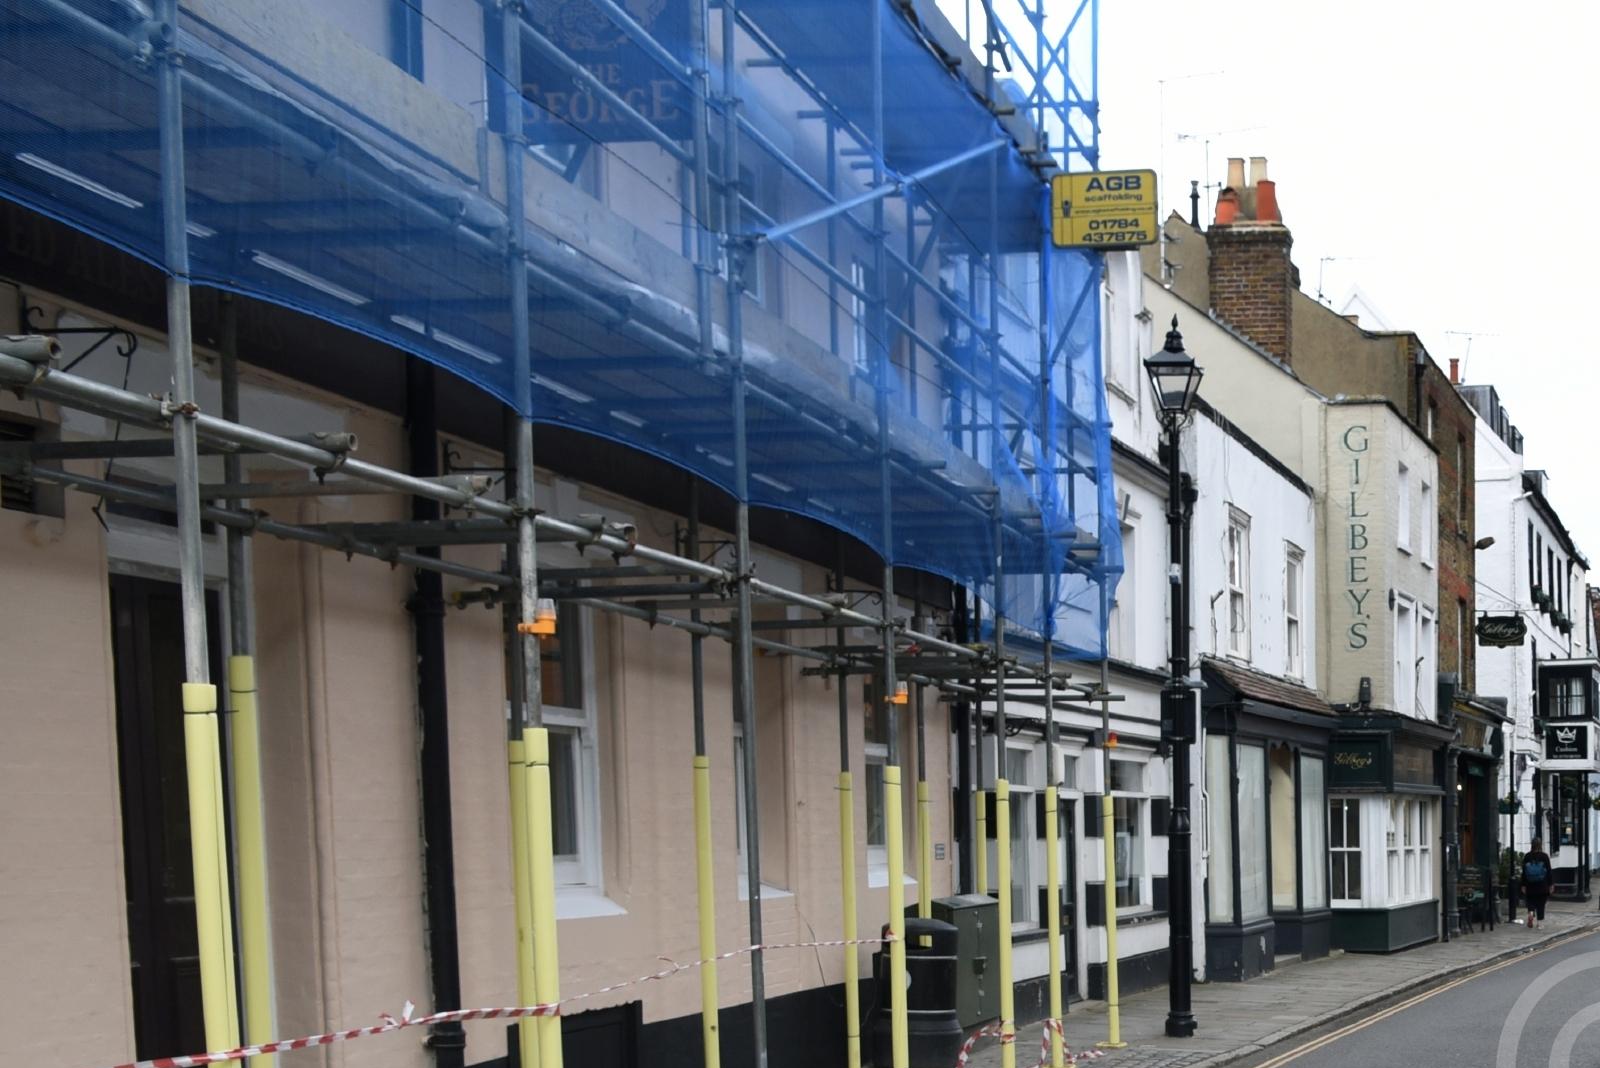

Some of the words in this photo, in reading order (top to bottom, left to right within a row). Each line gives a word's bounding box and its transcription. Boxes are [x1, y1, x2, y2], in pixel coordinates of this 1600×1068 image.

[1085, 175, 1142, 193] AGB
[1084, 193, 1143, 202] scaffolding
[1088, 218, 1140, 231] 01784
[1082, 231, 1148, 242] 437875
